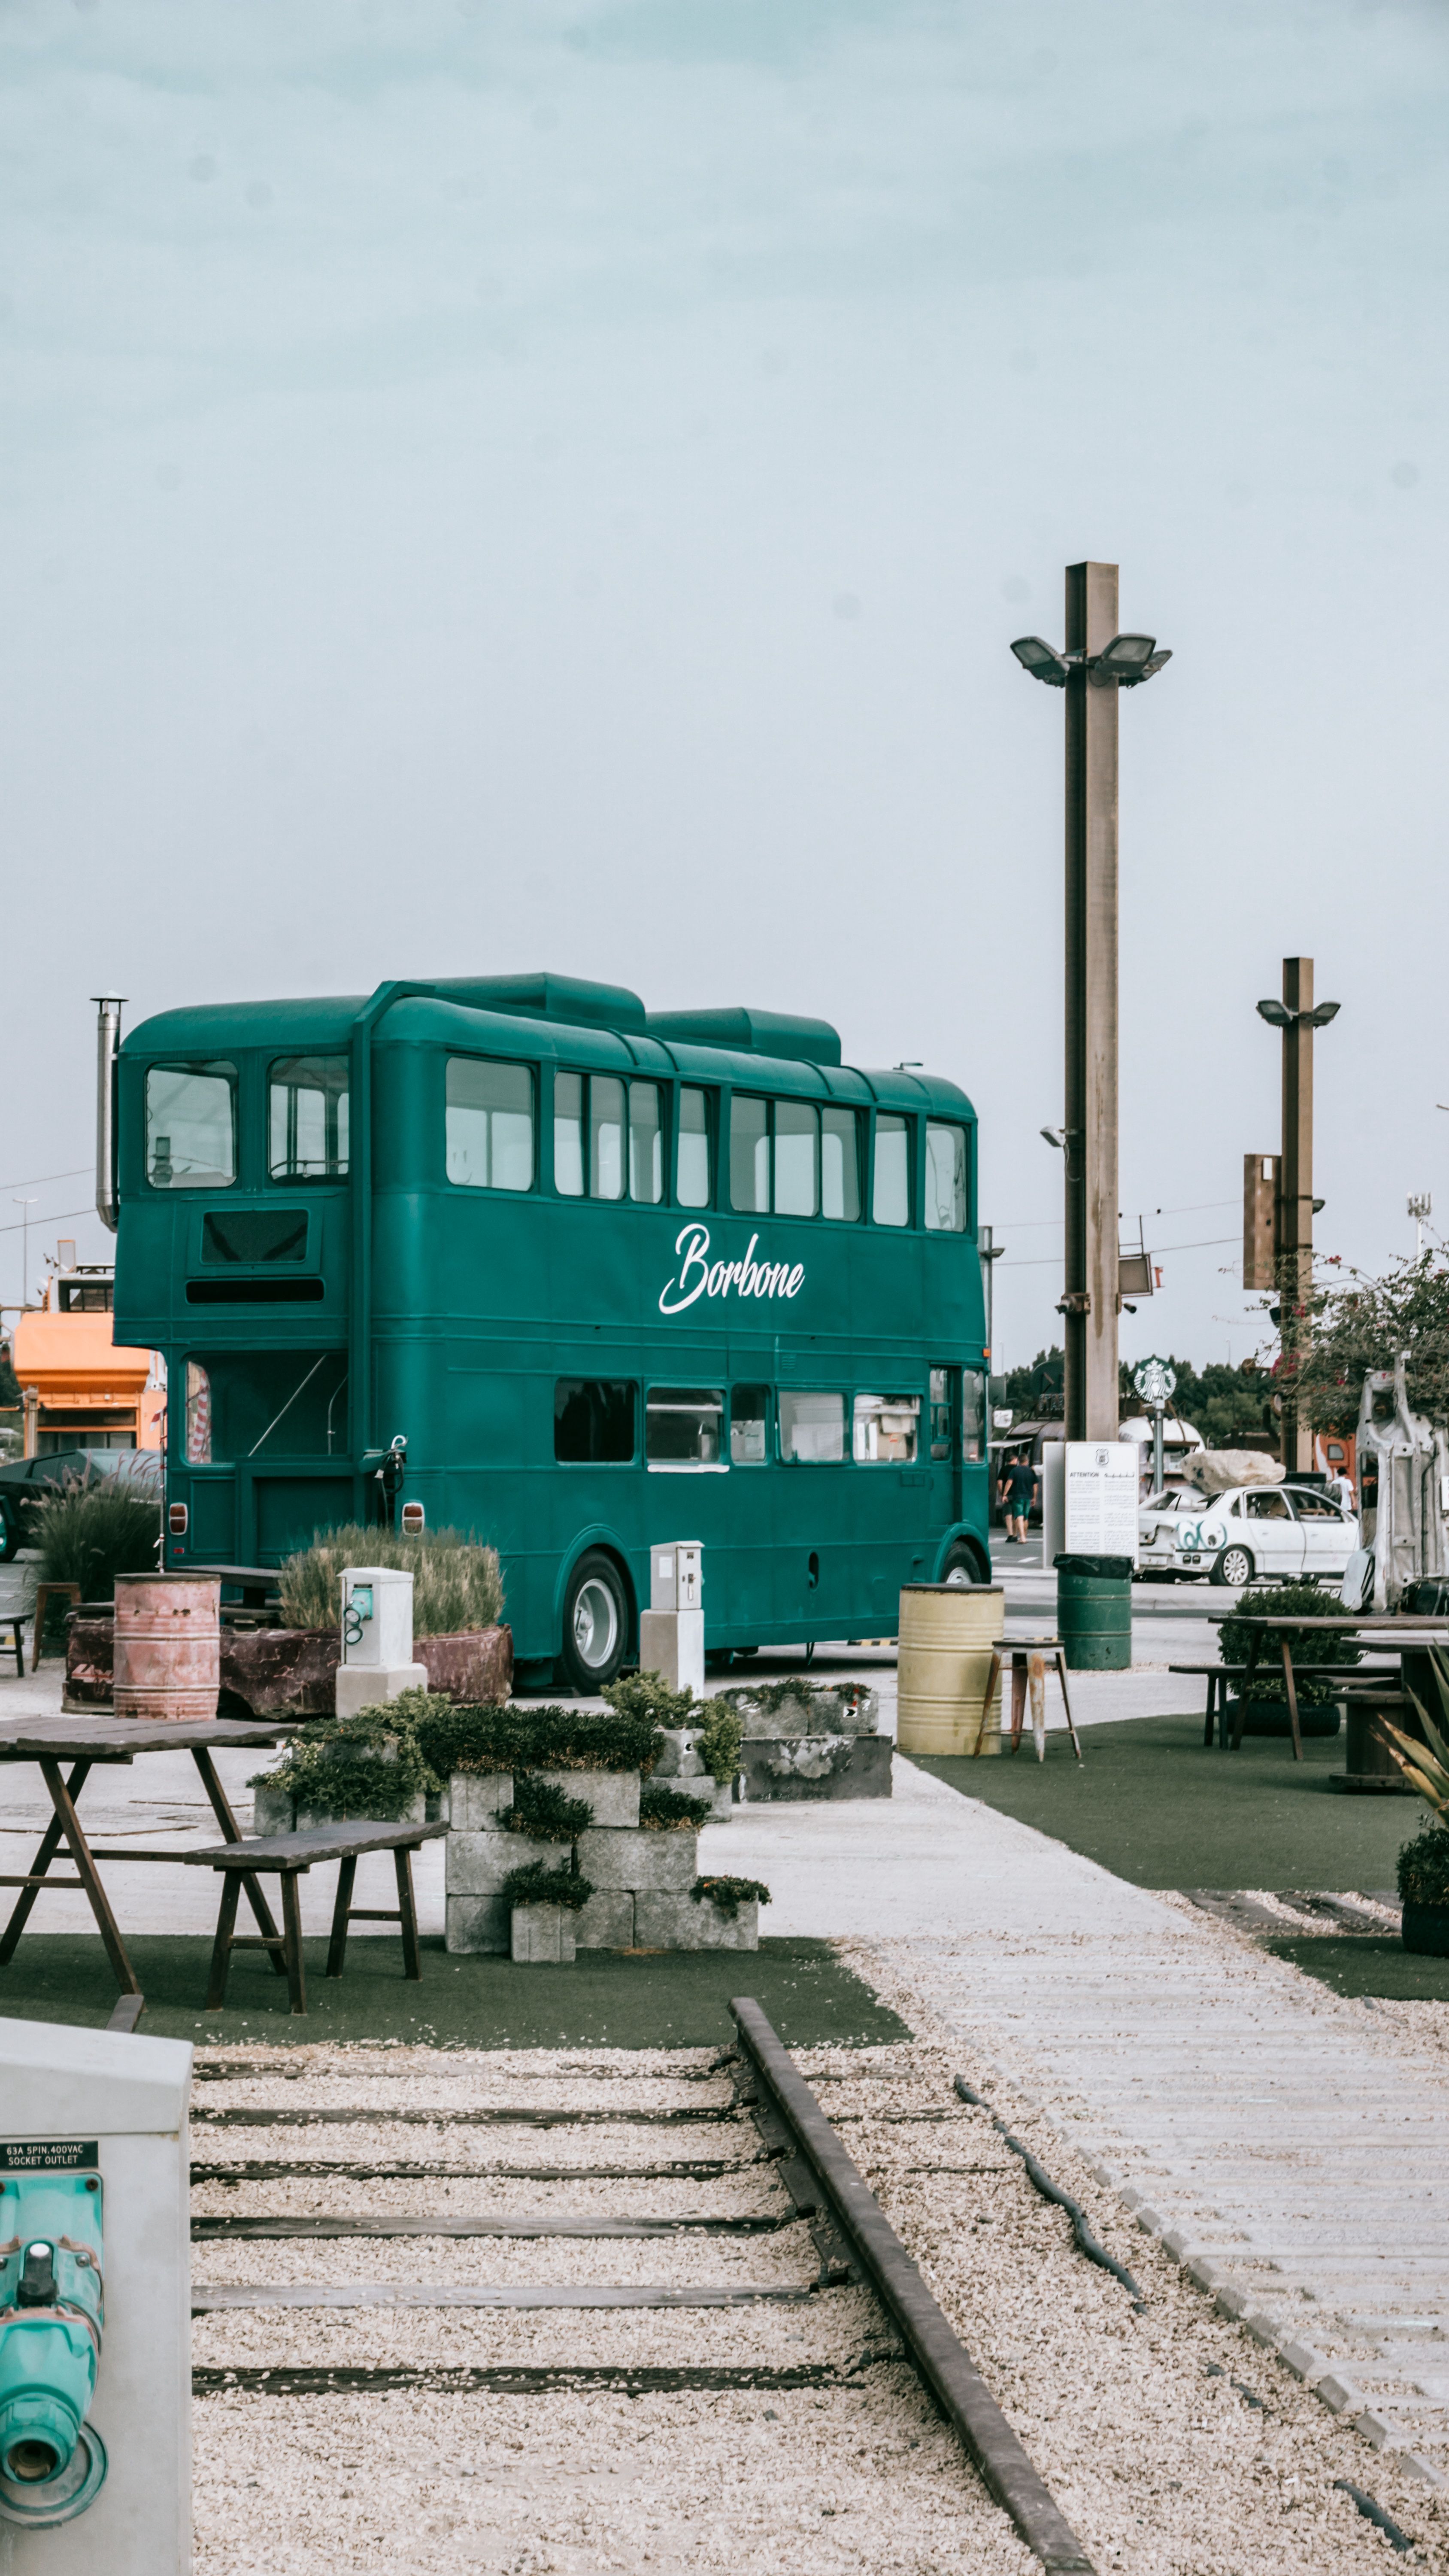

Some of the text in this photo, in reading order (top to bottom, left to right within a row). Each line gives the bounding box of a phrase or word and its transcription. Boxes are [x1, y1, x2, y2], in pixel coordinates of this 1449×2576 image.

[658, 1223, 805, 1315] Borbone
[7, 2146, 23, 2155] 63A
[8, 2155, 78, 2166] SOCKET OUTLET
